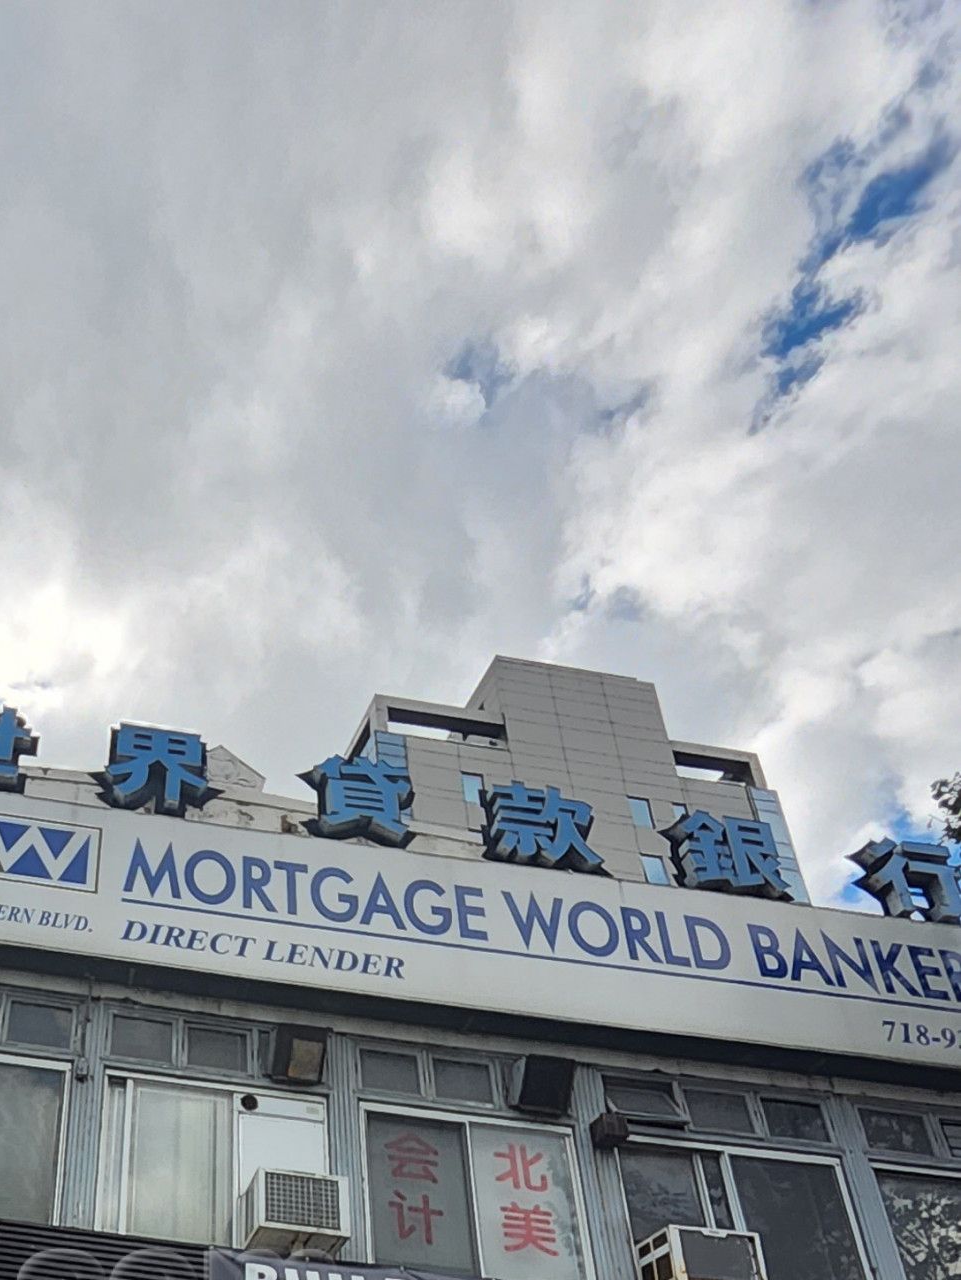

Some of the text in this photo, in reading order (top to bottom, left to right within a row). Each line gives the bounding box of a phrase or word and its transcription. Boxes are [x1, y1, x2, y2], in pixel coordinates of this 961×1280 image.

[37, 910, 94, 933] BLVD.
[123, 837, 488, 941] MORTGAGE
[501, 890, 732, 970] WORLD
[120, 920, 405, 980] DIRECT LENDER
[881, 1020, 961, 1049] 718-9
[384, 1133, 444, 1245] 会计
[494, 1143, 559, 1257] 北美
